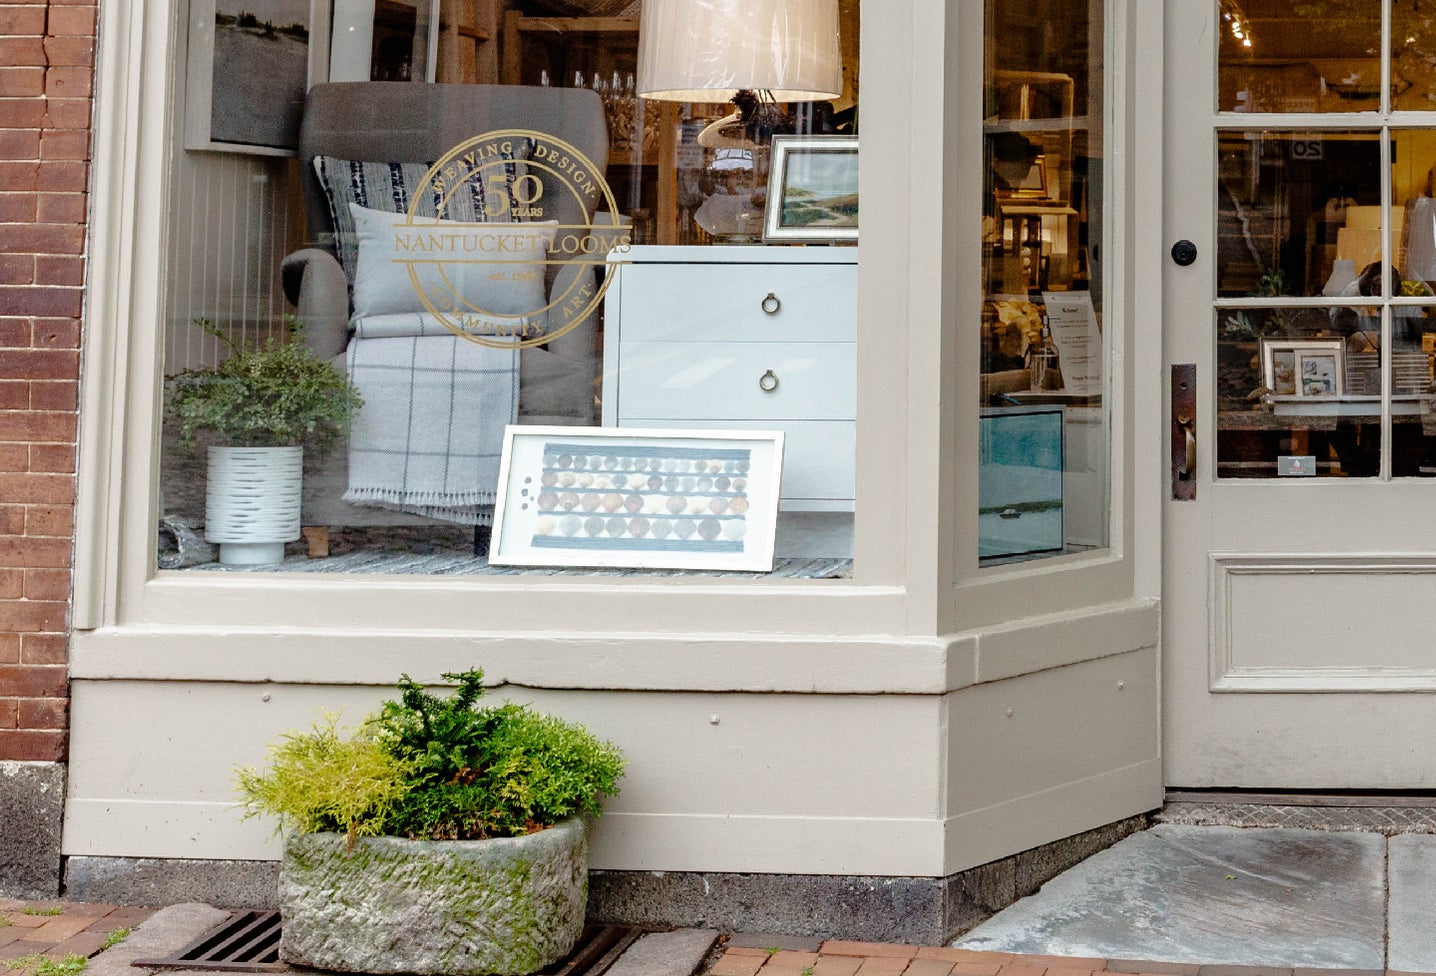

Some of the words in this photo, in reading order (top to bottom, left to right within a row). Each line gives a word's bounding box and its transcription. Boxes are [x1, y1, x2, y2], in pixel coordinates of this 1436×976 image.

[432, 141, 513, 192] WEAVING
[534, 145, 595, 196] DESIGN
[485, 174, 543, 217] 50
[511, 208, 543, 217] YEARS
[394, 234, 541, 253] NANTUCKET
[547, 235, 631, 254] LOOMS
[431, 285, 543, 337] COMMUNITY
[562, 285, 592, 319] ART
